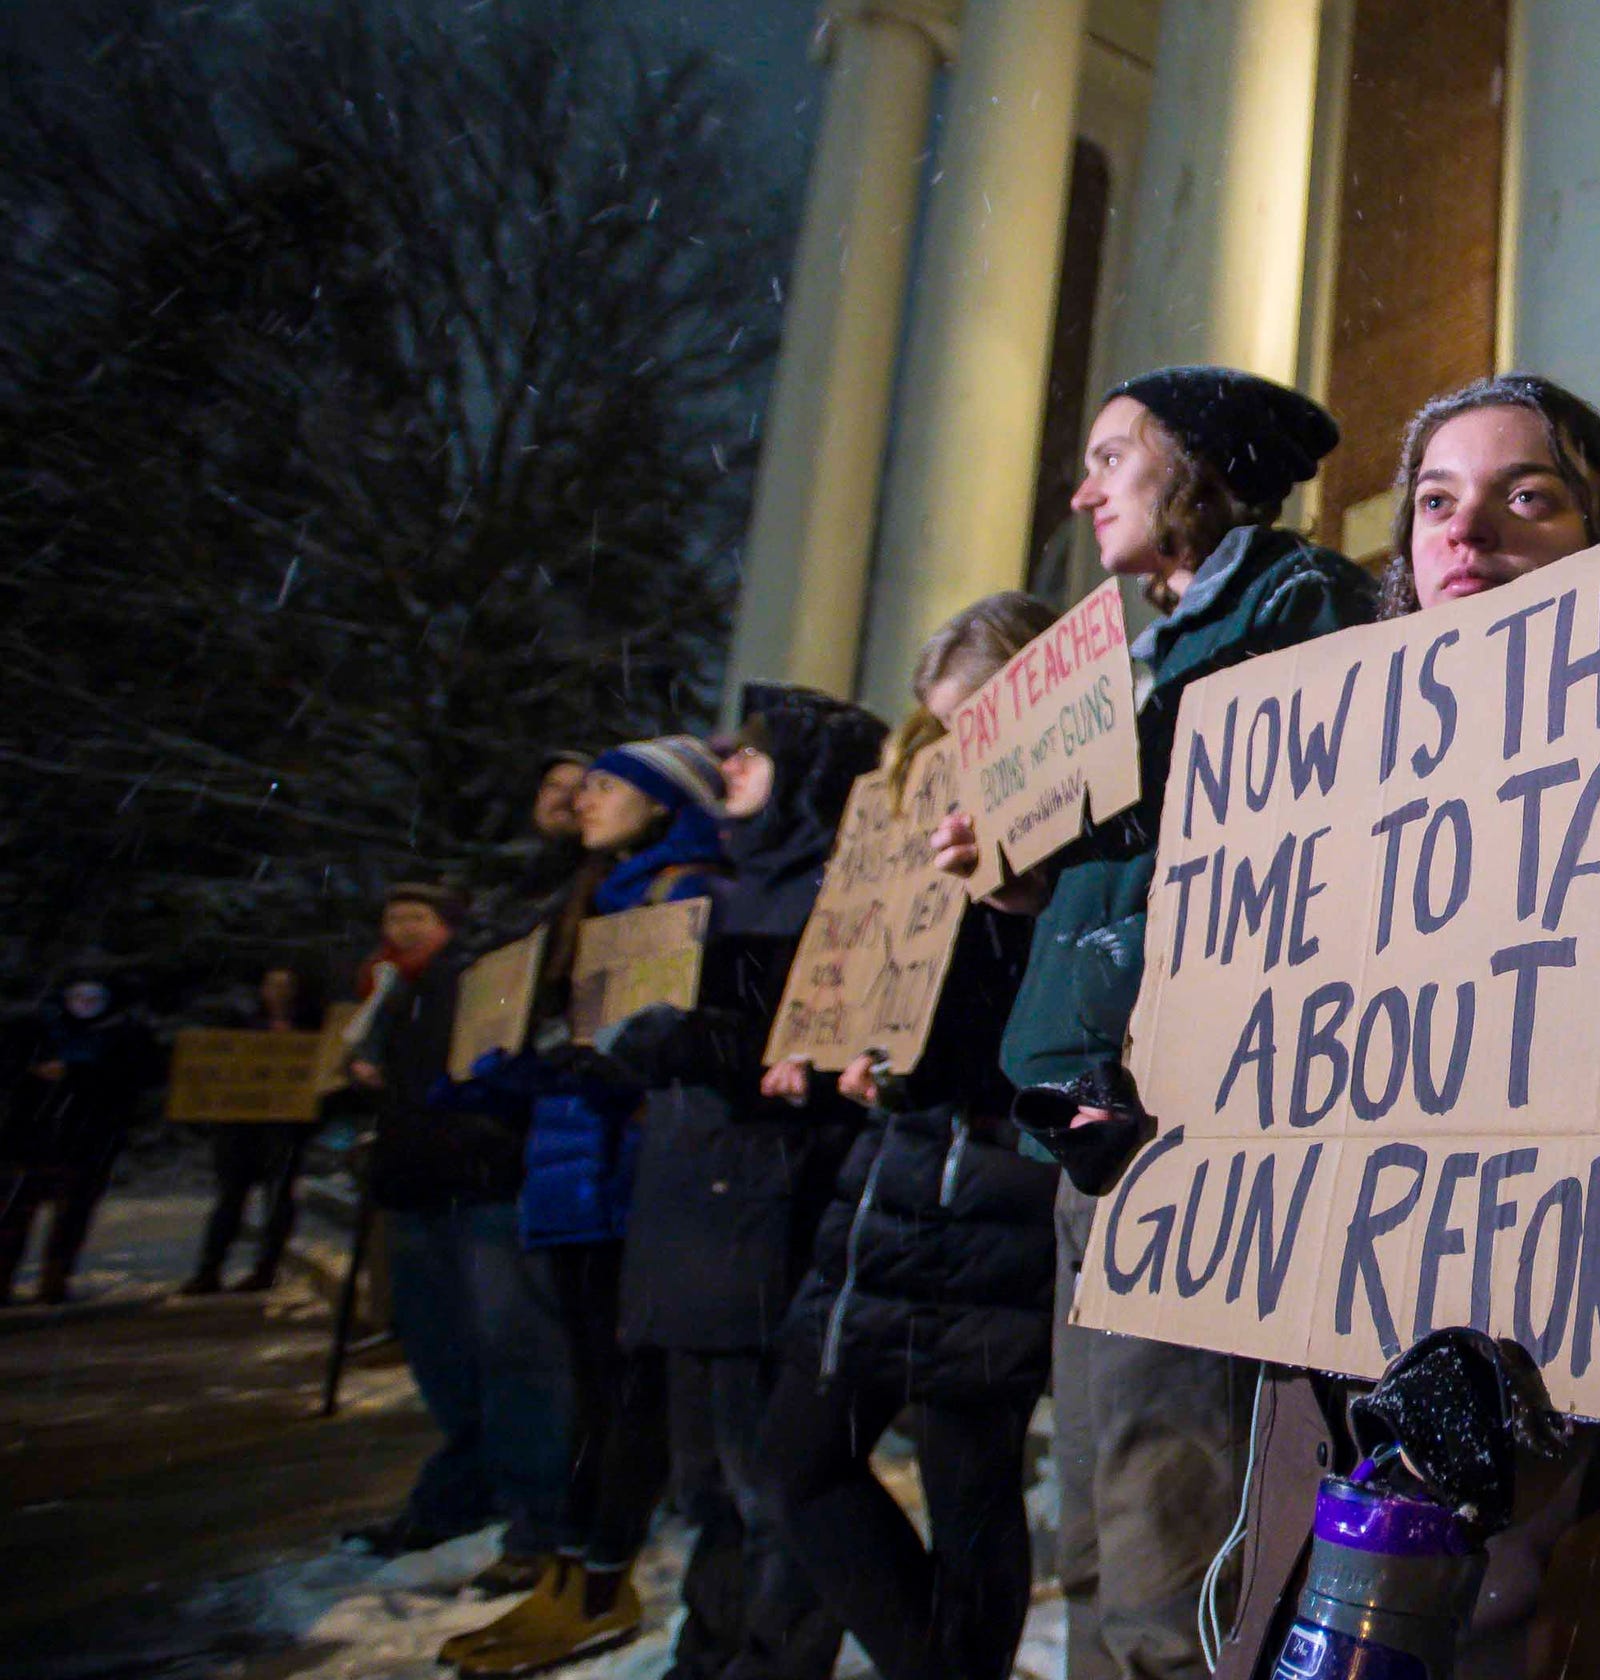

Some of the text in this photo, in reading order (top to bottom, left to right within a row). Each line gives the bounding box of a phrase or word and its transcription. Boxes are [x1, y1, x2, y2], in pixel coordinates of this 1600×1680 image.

[957, 589, 1124, 771] PAY TEACHER
[1031, 724, 1056, 770] NOT
[1060, 675, 1115, 757] GUNS
[1182, 661, 1361, 839] NOW
[1379, 628, 1459, 785] IS
[1165, 826, 1331, 978] TIME
[1371, 797, 1473, 956] TO
[1215, 937, 1577, 1130] ABOUT
[1102, 1125, 1323, 1321] GUN
